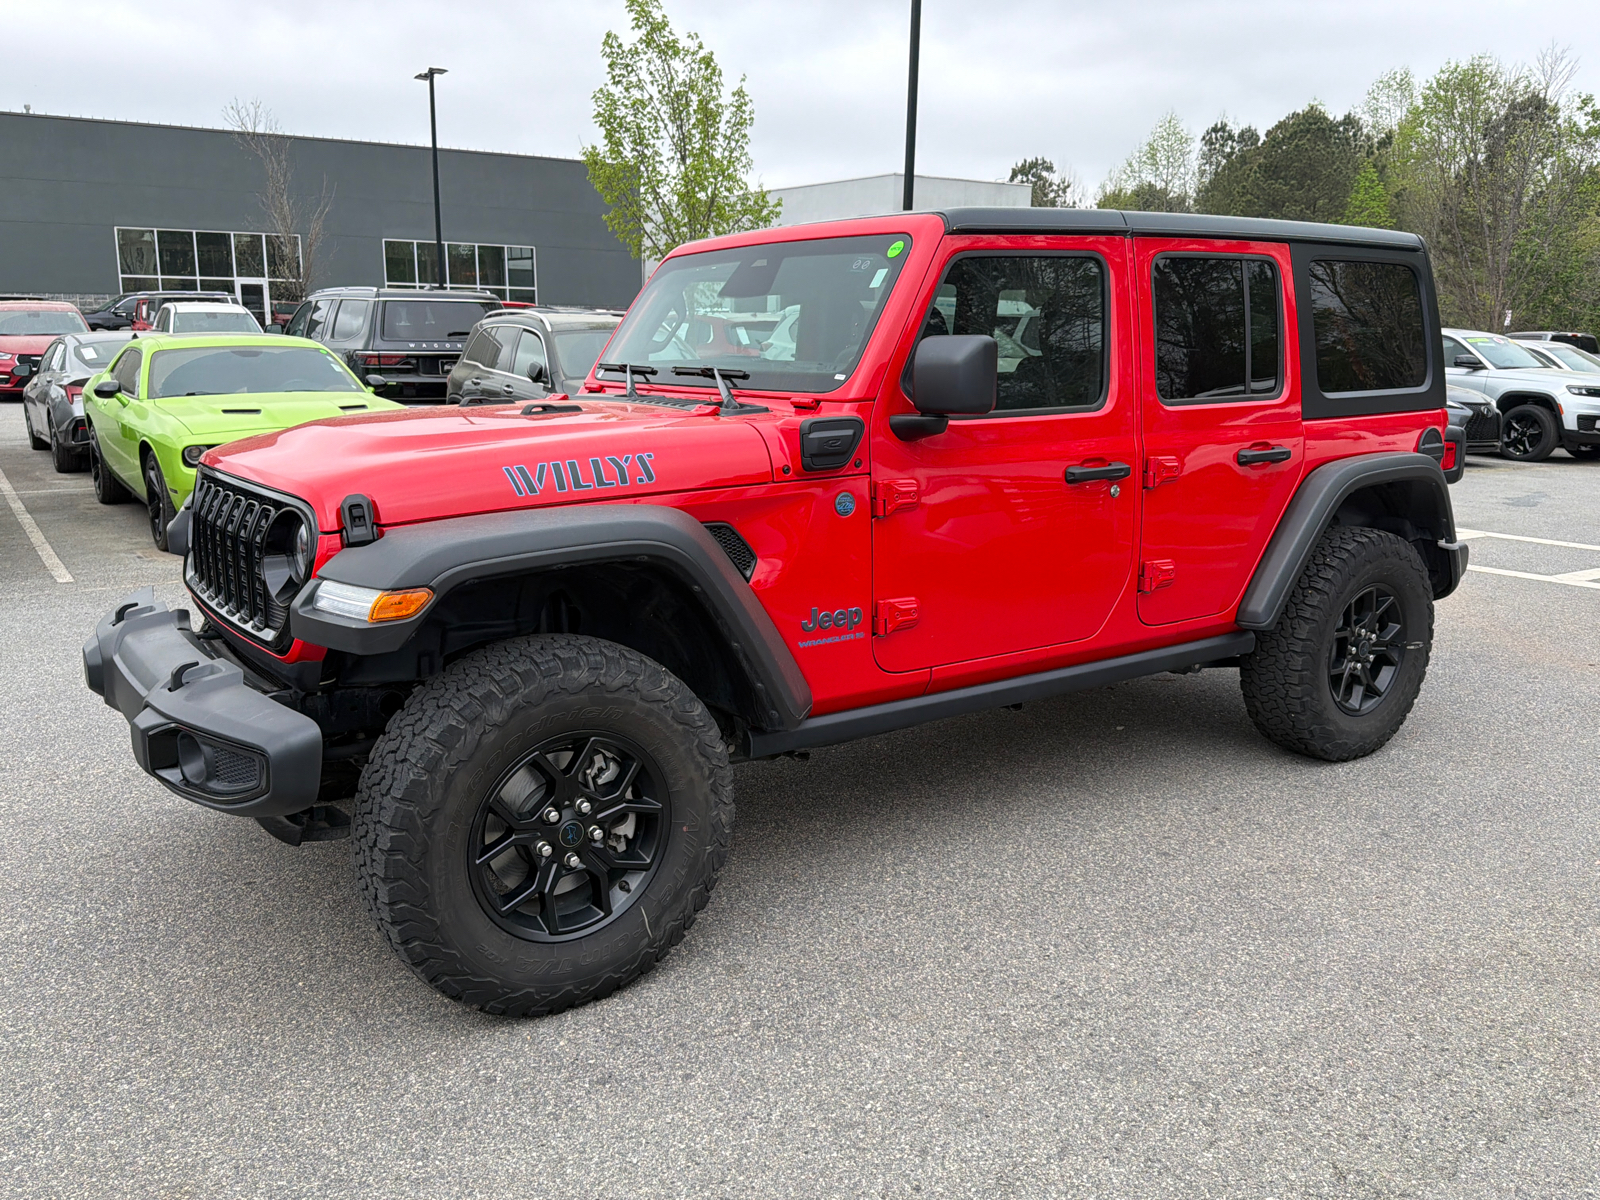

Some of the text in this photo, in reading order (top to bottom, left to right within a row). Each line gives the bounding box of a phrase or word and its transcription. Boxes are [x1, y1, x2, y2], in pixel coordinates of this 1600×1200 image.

[502, 452, 655, 497] WILLYS
[801, 606, 863, 632] Jeep
[798, 633, 855, 648] WRANGLER
[446, 705, 624, 851] BFGoodrich
